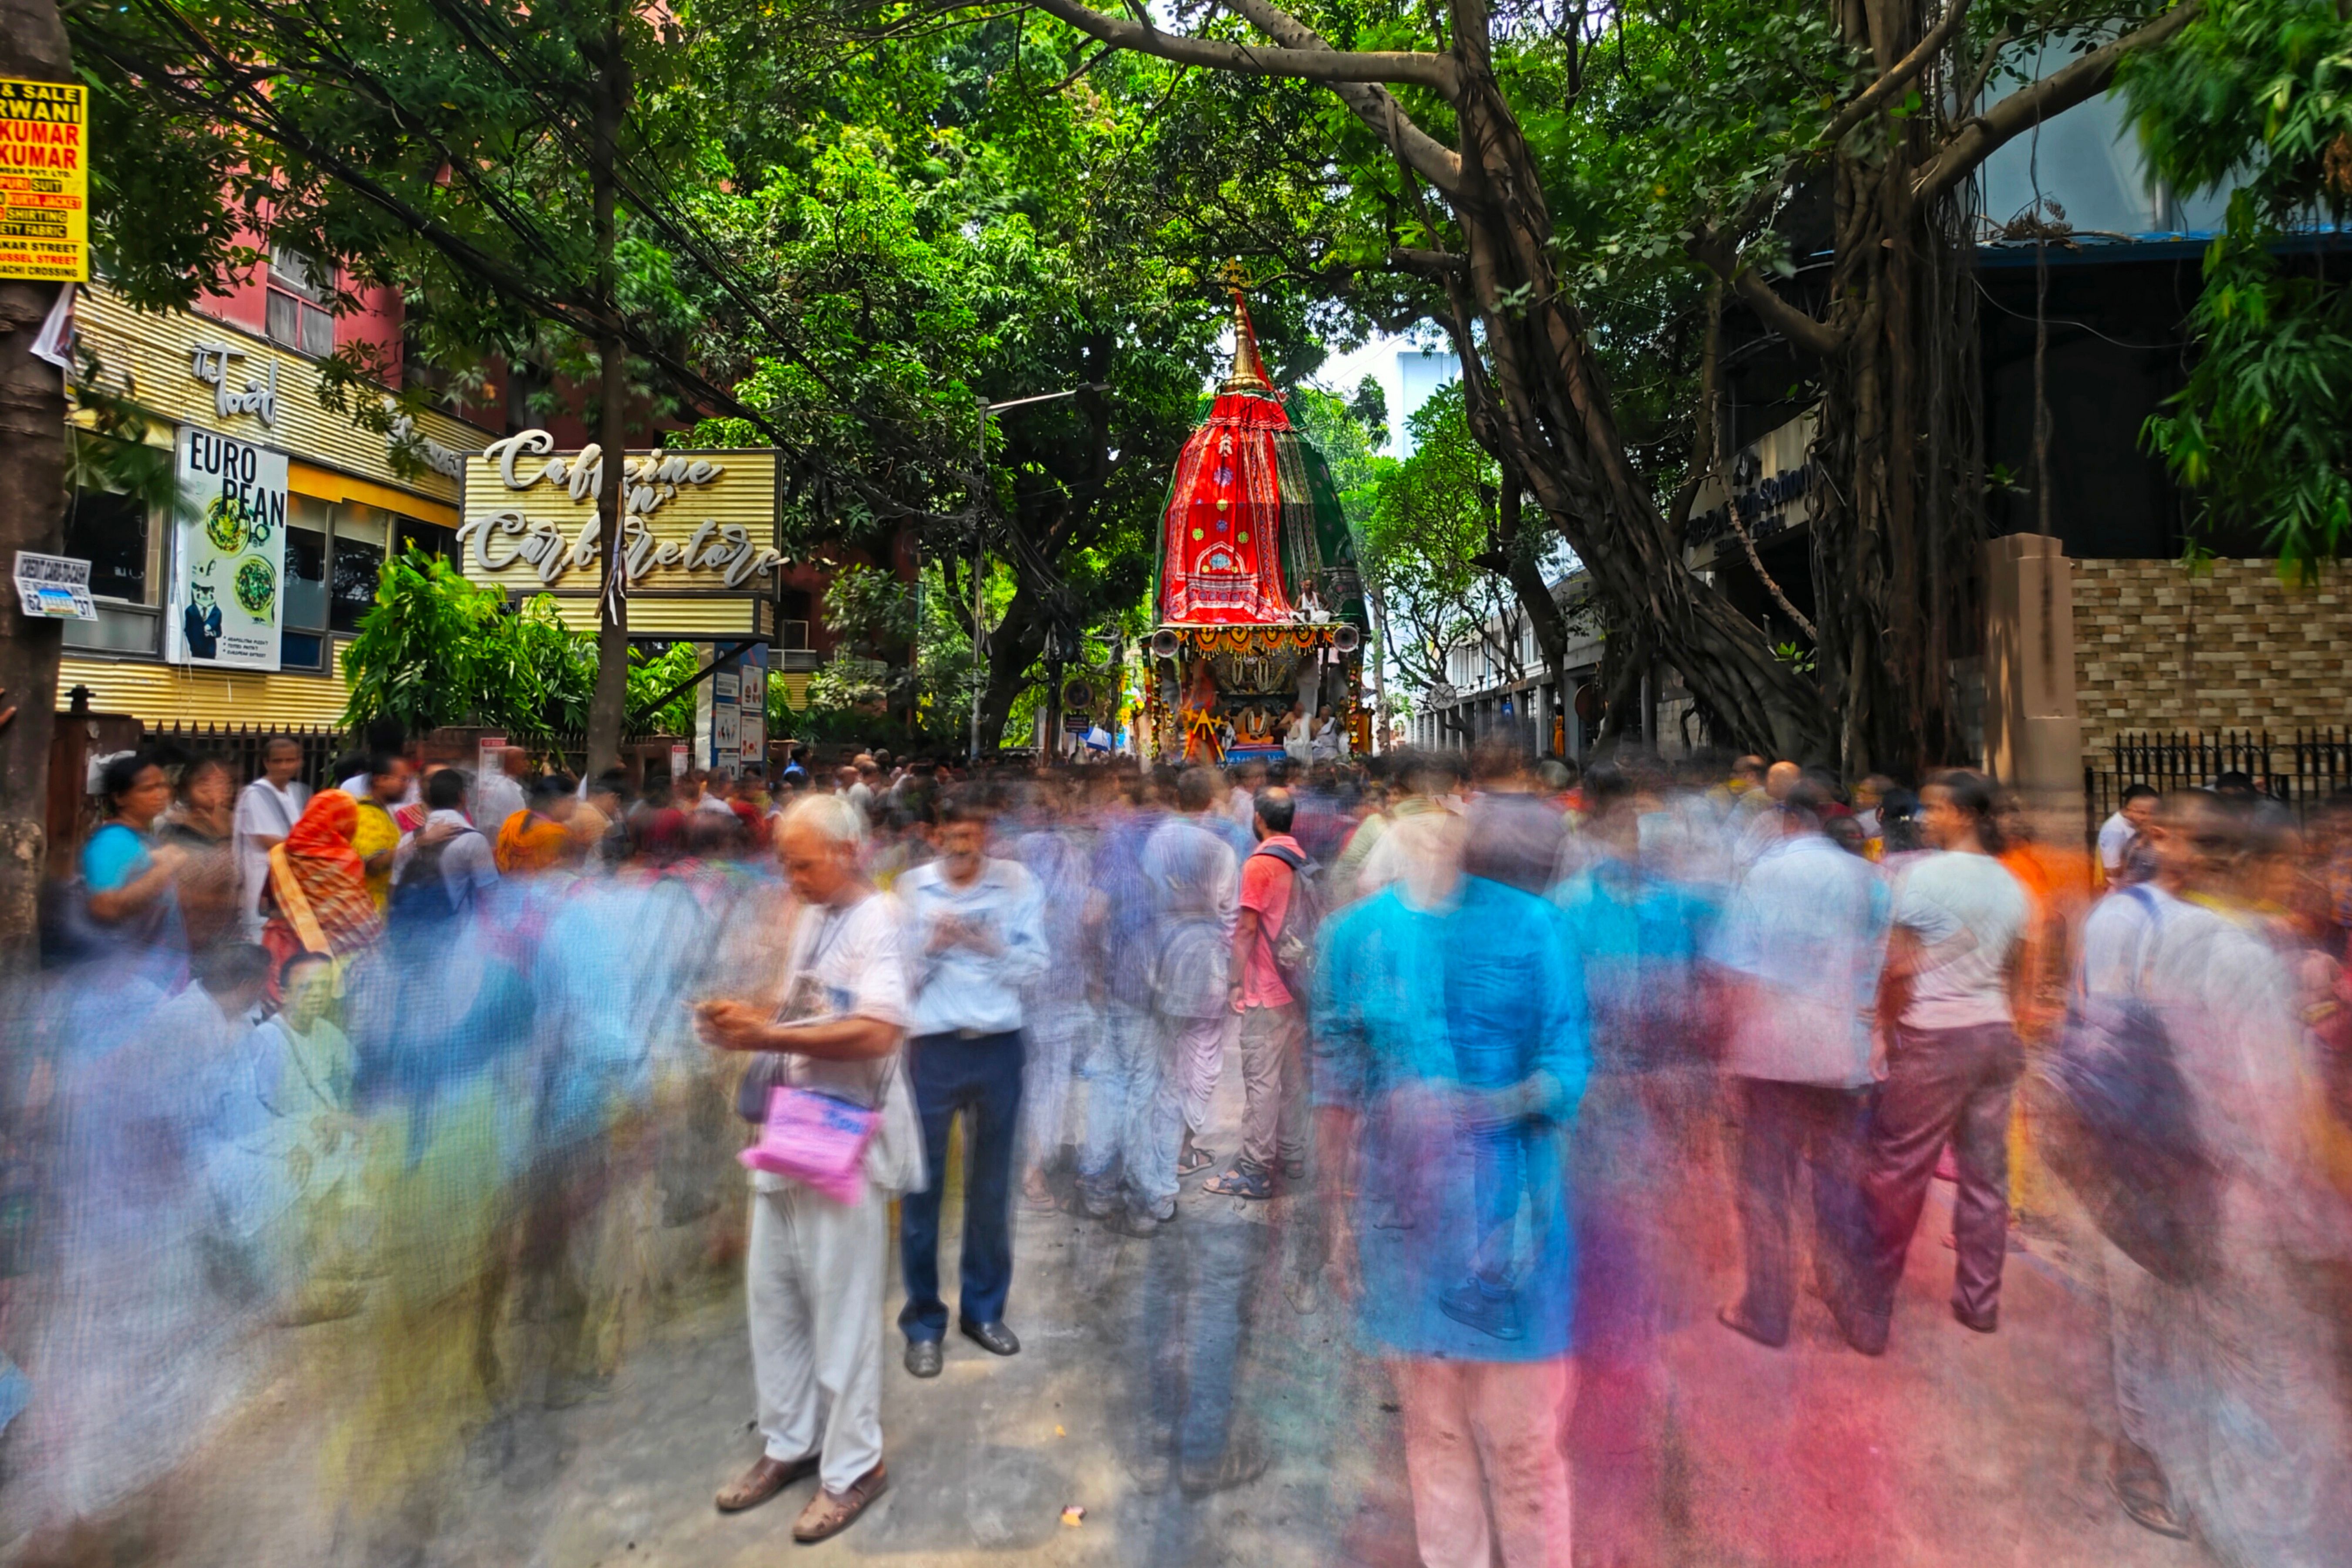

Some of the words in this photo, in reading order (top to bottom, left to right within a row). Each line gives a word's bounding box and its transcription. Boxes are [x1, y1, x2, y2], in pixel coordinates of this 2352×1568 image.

[1, 84, 16, 97] &
[22, 85, 78, 103] SALE
[0, 120, 80, 146] KUMAR
[0, 144, 78, 170] KUMAR
[32, 179, 61, 192] SUIT
[8, 194, 41, 206] KURTA
[43, 196, 81, 208] JACKET
[7, 208, 67, 222] SHIRTING
[25, 225, 65, 237] FABRIC
[31, 243, 78, 253] STREET
[37, 254, 78, 265] STREET
[28, 266, 78, 278] CROSSING
[190, 431, 257, 484] EURO
[221, 477, 285, 528] PEAN
[456, 509, 791, 588] Carbretors
